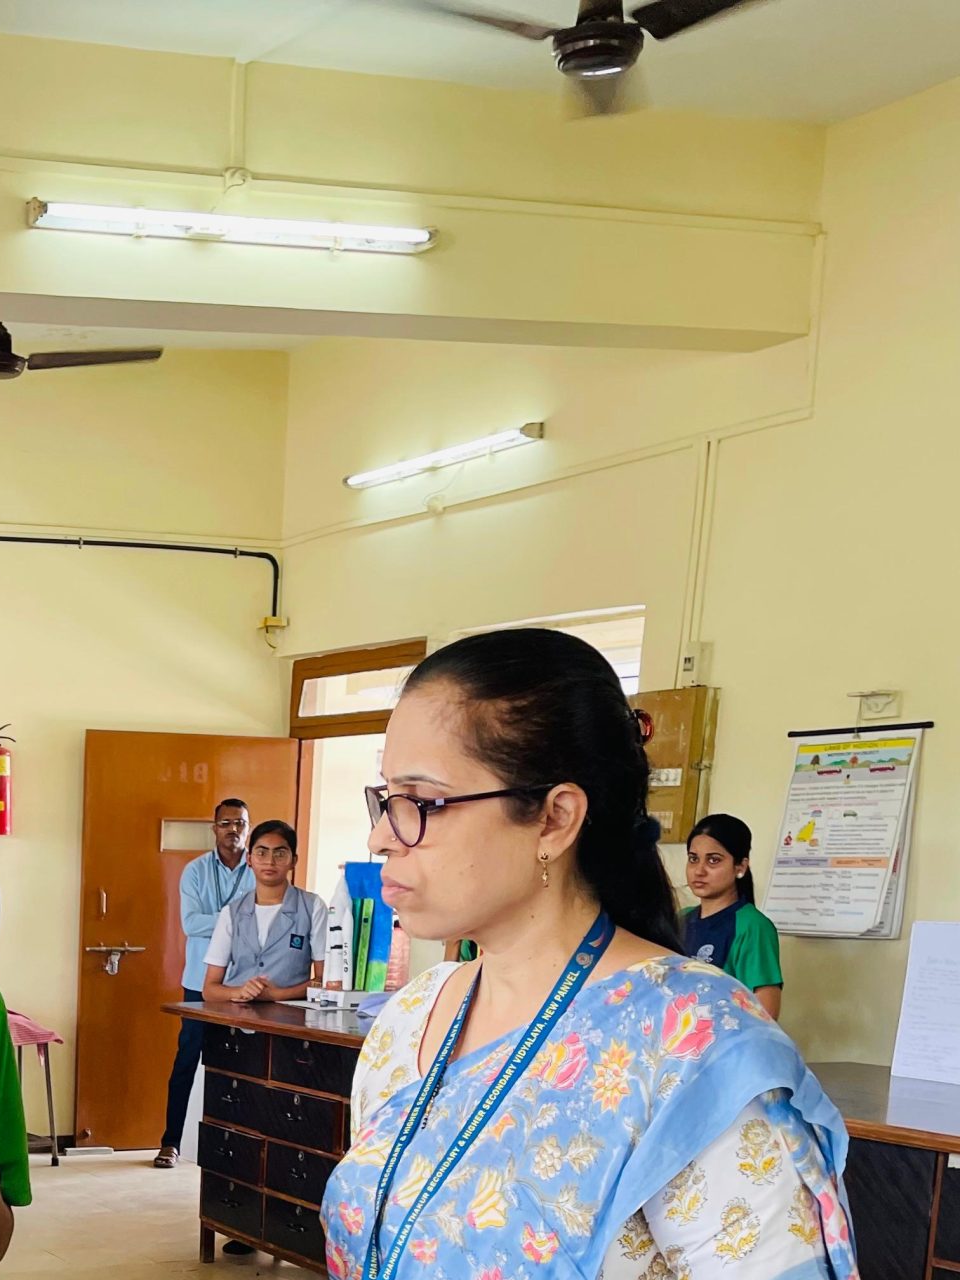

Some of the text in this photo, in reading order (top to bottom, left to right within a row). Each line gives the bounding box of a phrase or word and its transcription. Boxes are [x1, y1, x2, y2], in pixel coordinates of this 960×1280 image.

[383, 1246, 401, 1280] CHANGU
[399, 1224, 412, 1246] KANA
[408, 1192, 430, 1223] THAKUR
[427, 1146, 460, 1193] SECONDARY
[462, 1110, 486, 1140] HIGHER
[482, 1063, 517, 1110] SECONDARY
[541, 1001, 560, 1021] NEW
